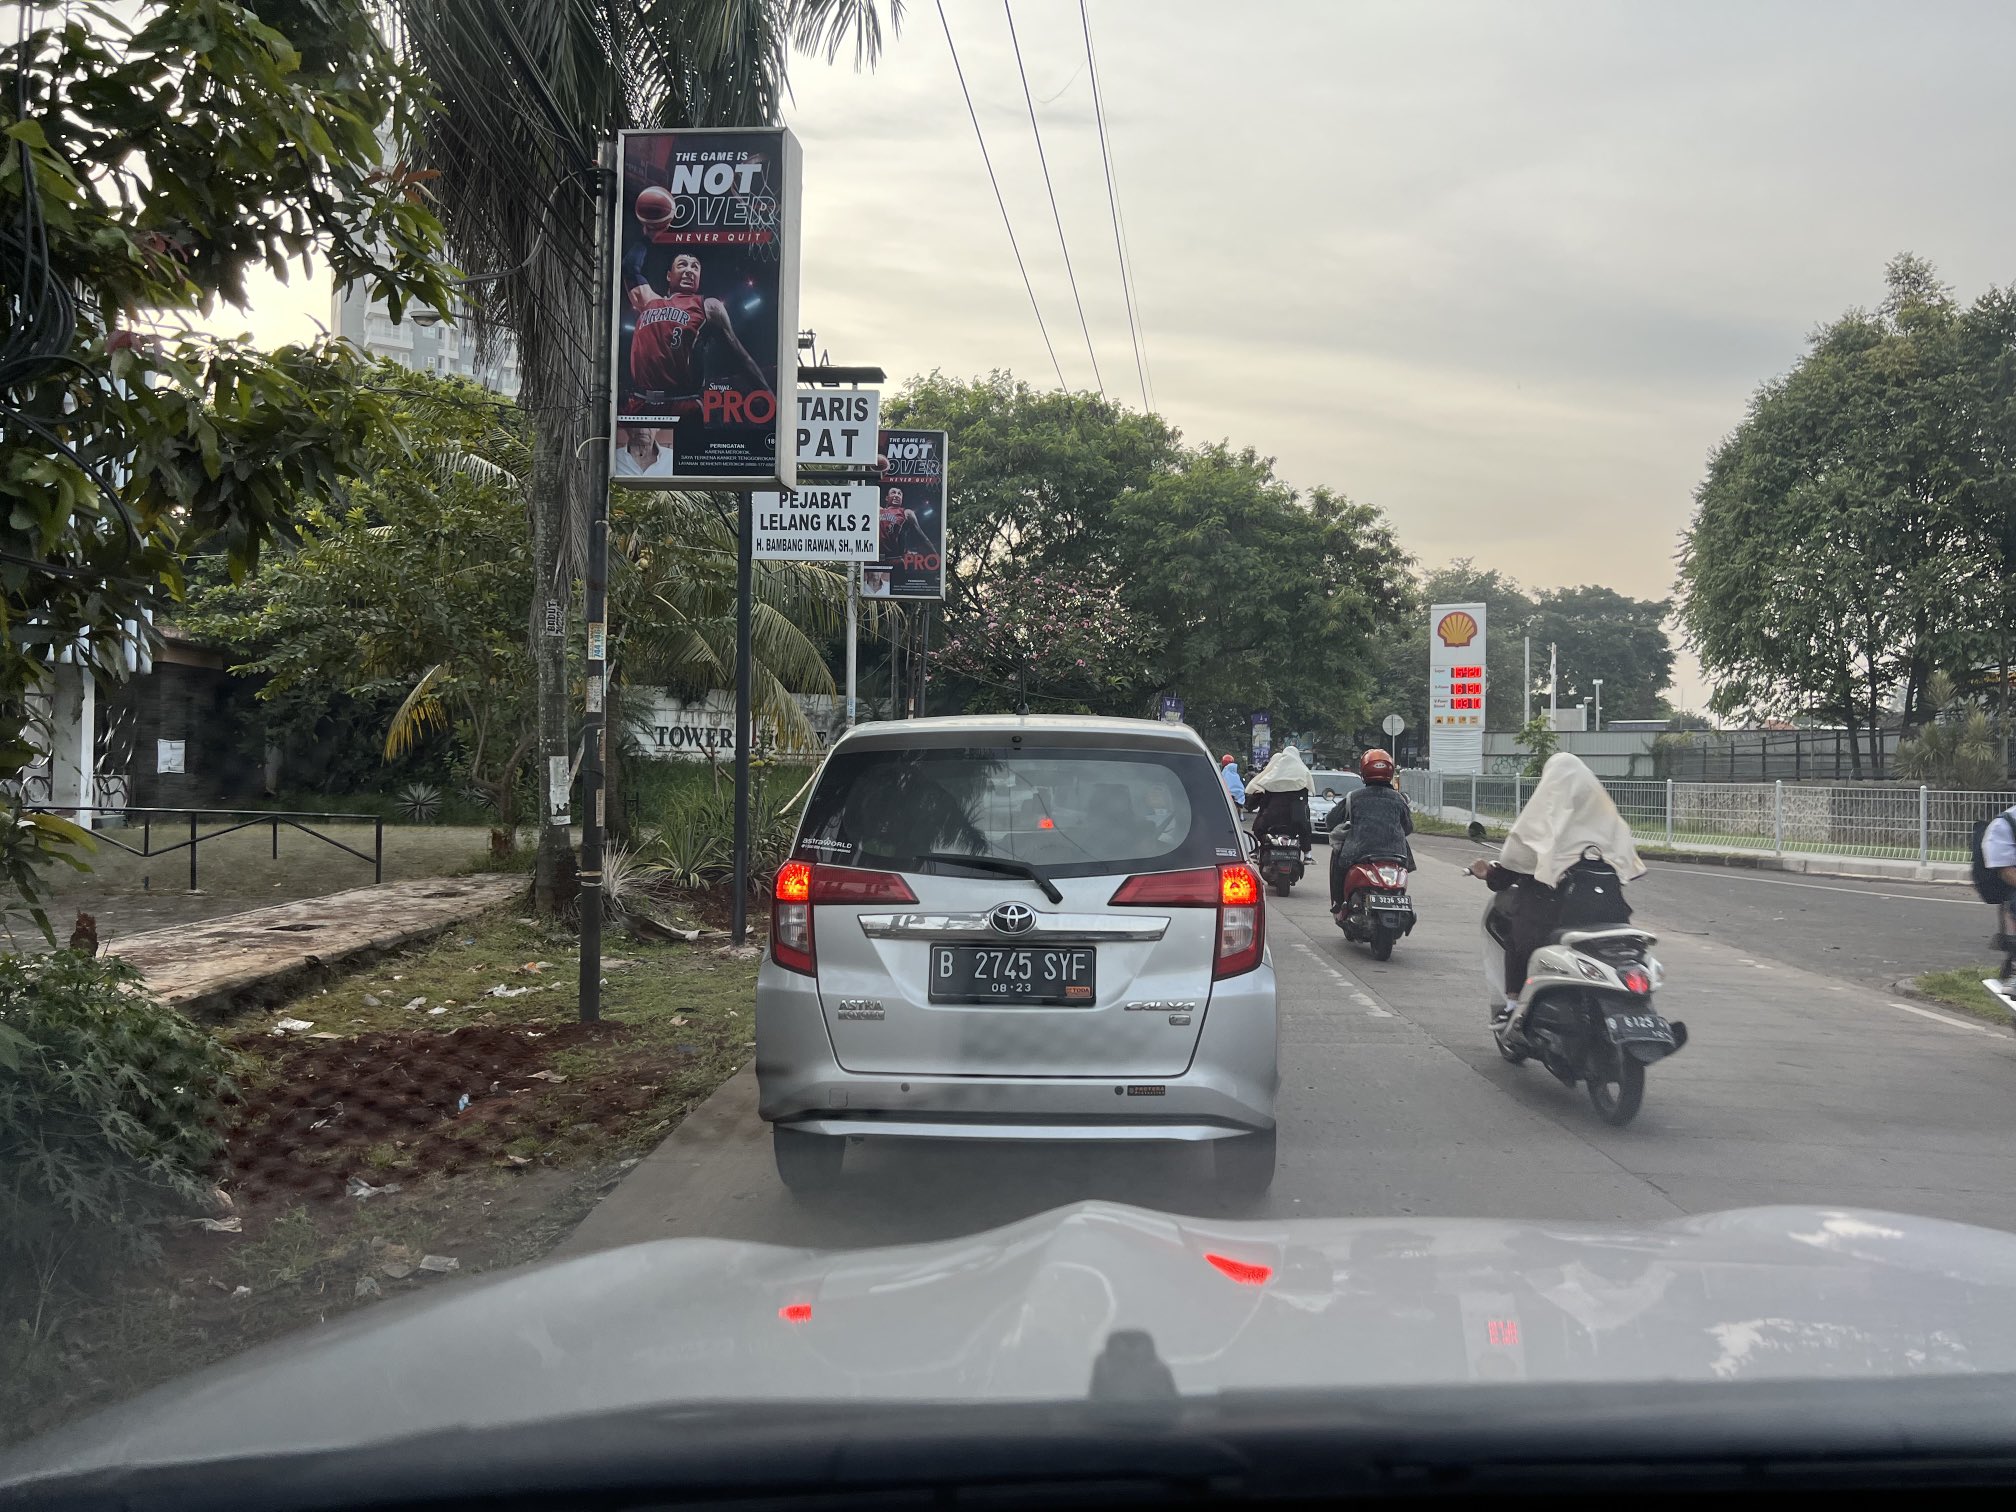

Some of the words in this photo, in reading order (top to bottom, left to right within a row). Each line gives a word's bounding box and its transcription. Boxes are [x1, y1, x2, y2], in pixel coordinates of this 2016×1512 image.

[676, 152, 696, 162] THE
[701, 152, 733, 161] GAME
[737, 151, 748, 161] IS
[671, 163, 762, 195] NOT
[669, 195, 776, 228] OVER
[675, 233, 719, 242] NEVER
[727, 233, 761, 242] QUIT
[671, 327, 682, 349] 3
[703, 390, 777, 424] PRO
[887, 443, 932, 459] NOT
[886, 459, 940, 475] OVER
[779, 491, 852, 509] PEJABAT
[760, 514, 821, 531] LELANG
[827, 514, 856, 531] KLS
[862, 514, 870, 531] 2
[756, 538, 764, 551] H.
[766, 538, 803, 551] BAMBANG
[805, 539, 837, 554] IRAWAN,
[855, 539, 874, 552] M.Kn
[904, 554, 941, 570] PRO
[655, 726, 734, 749] TOWER
[940, 951, 953, 978] B
[974, 951, 1032, 980] 2745
[1044, 953, 1086, 981] SYF
[839, 1000, 883, 1010] ASTRA
